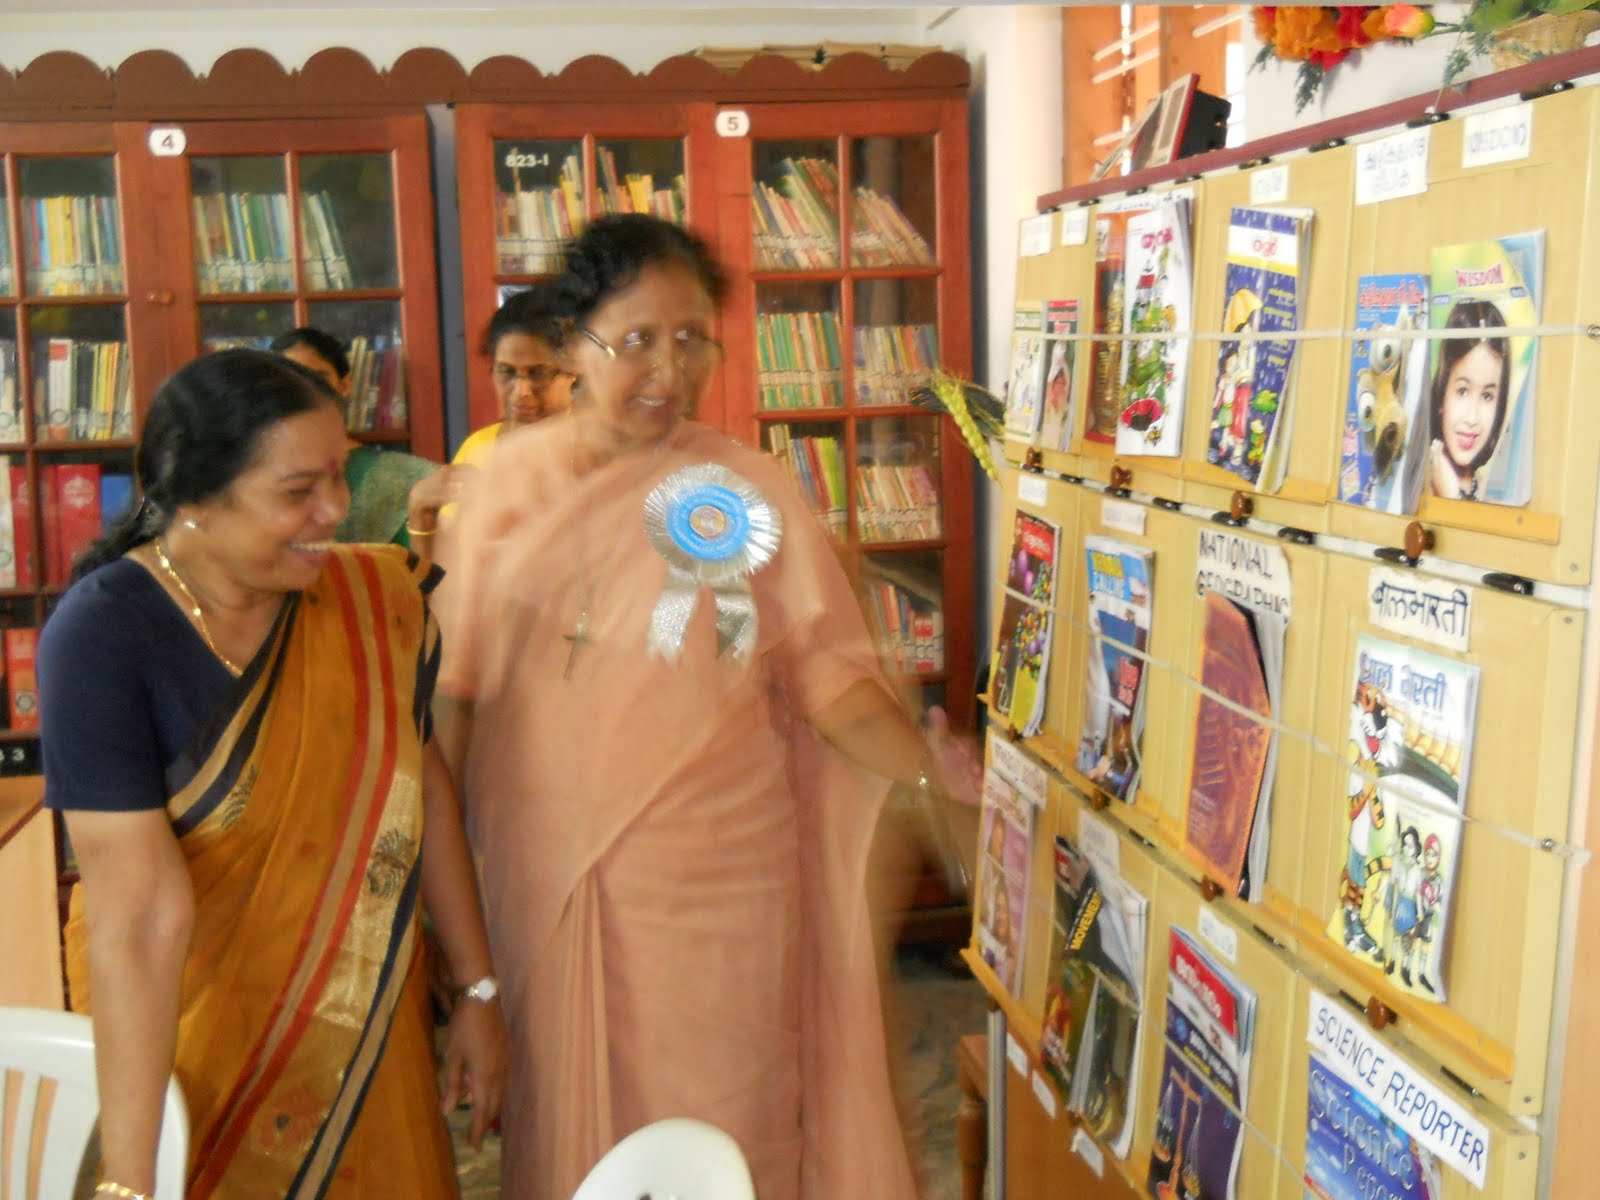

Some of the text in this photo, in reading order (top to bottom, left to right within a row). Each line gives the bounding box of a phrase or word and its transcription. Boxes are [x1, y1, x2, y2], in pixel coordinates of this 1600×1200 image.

[728, 117, 738, 131] 5
[162, 134, 174, 149] 4
[1455, 264, 1504, 288] WISDOM
[1200, 530, 1273, 579] NATIONAL
[1315, 1007, 1386, 1088] SCIENCE
[1382, 1071, 1485, 1172] REPORTER
